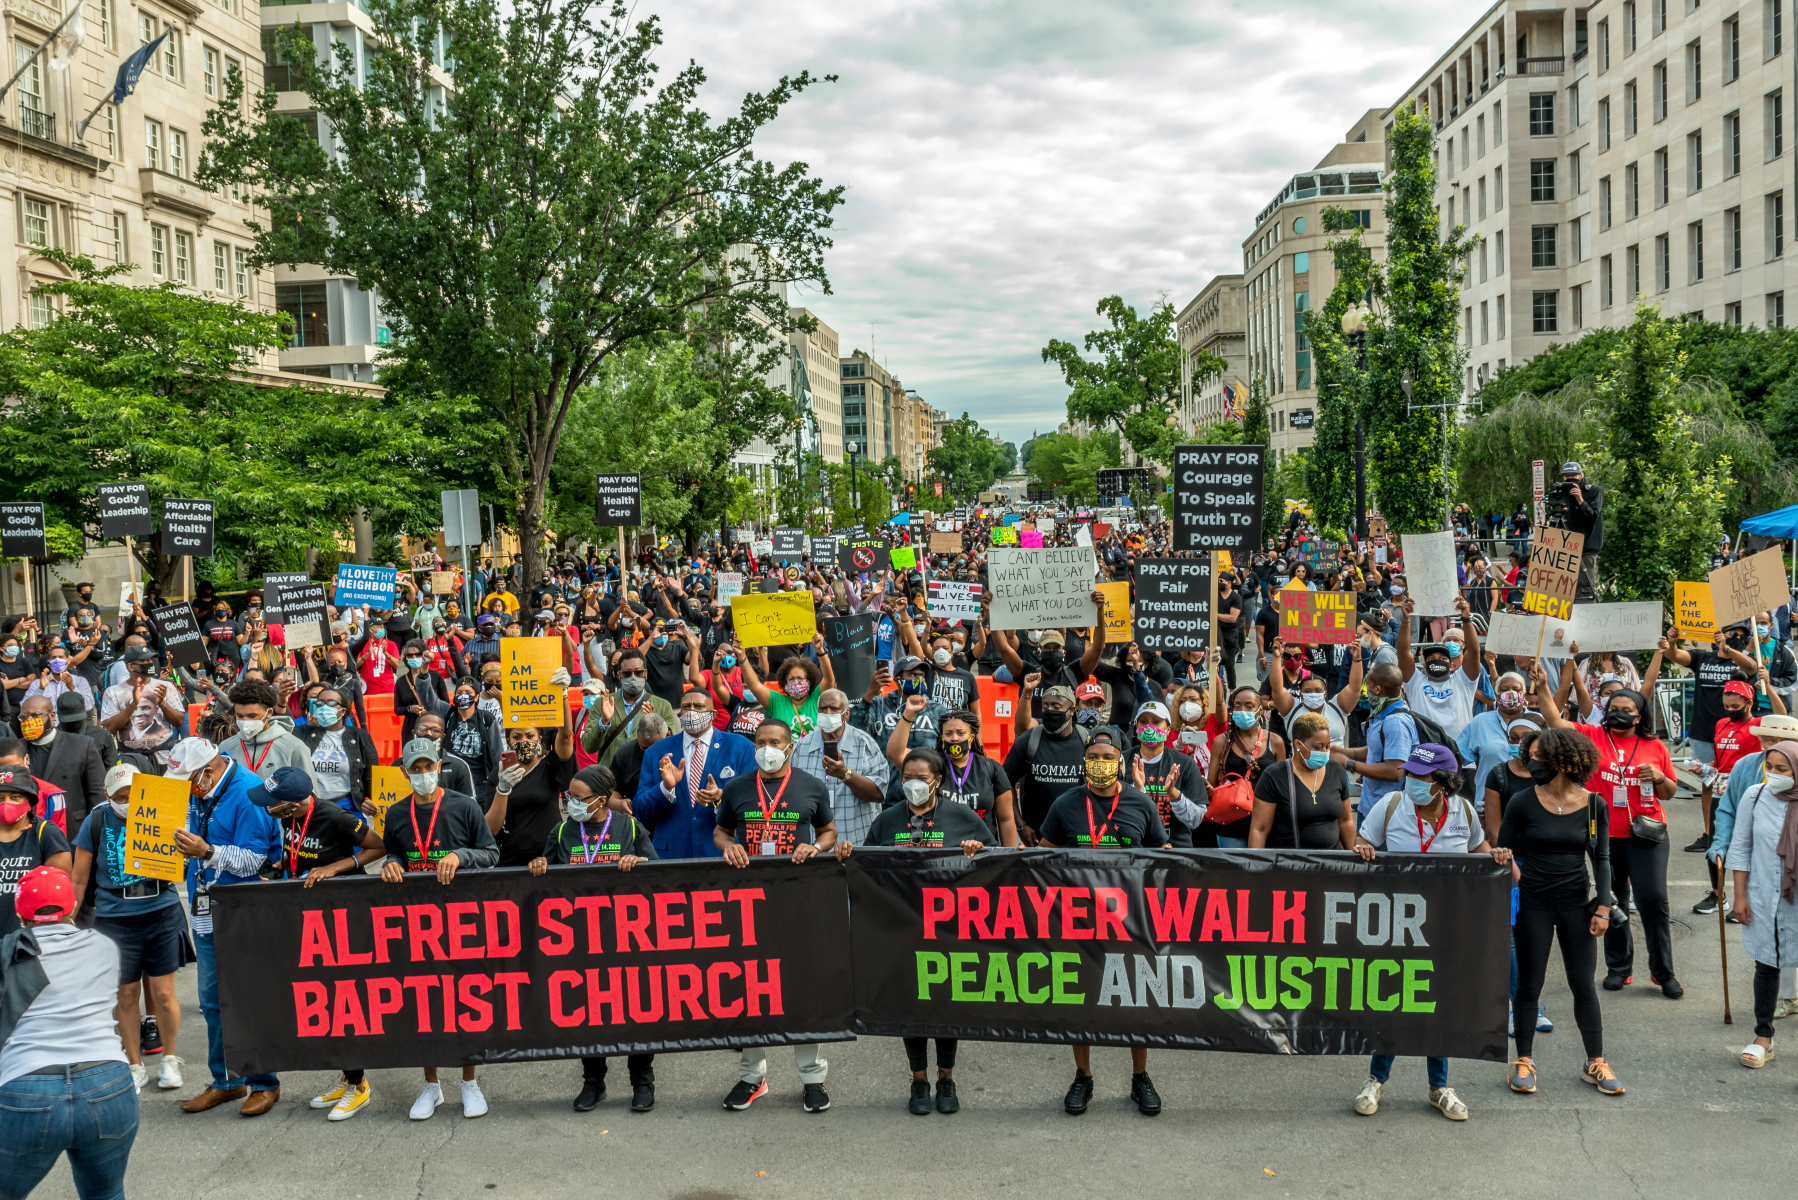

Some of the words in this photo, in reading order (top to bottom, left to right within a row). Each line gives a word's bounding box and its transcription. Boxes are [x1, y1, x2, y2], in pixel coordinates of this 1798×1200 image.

[1178, 452, 1222, 465] PRAY
[1226, 453, 1259, 465] FOR
[598, 476, 620, 484] PRAY
[1182, 470, 1253, 487] Courage
[101, 486, 125, 495] PRAY
[126, 484, 145, 493] FOR
[598, 485, 639, 493] Affordable
[108, 494, 140, 505] Godly
[165, 501, 190, 510] PRAY
[192, 503, 212, 511] FOR
[602, 495, 635, 505] Health
[1178, 491, 1201, 505] To
[1204, 491, 1256, 508] Speak
[1, 506, 24, 514] PRAY
[24, 506, 41, 514] FOR
[102, 505, 149, 518] Leadership
[608, 508, 631, 517] Care
[7, 516, 36, 525] Godly
[164, 512, 212, 522] Affordable
[1181, 512, 1226, 526] Truth
[1230, 512, 1252, 526] To
[2, 528, 44, 538] Leadership
[168, 523, 207, 534] Health
[173, 536, 201, 547] Care
[839, 538, 849, 546] NO
[851, 540, 884, 549] JUSTICE
[1190, 533, 1243, 546] Power
[1045, 549, 1090, 564] BELIEVE
[1299, 551, 1319, 562] Black
[1531, 545, 1580, 574] KNEE
[994, 567, 1031, 581] WHAT
[1039, 567, 1059, 579] YOU
[1063, 566, 1084, 578] SAY
[1140, 564, 1178, 576] PRAY
[1181, 565, 1210, 576] FOR
[1729, 557, 1757, 578] BLACK
[266, 575, 288, 584] PRAY
[289, 574, 307, 582] FOR
[338, 578, 395, 593] NEIGHBOR
[1530, 567, 1556, 591] OFF
[1555, 573, 1578, 597] MY
[1731, 569, 1760, 594] LIVES
[941, 582, 969, 591] BLACK
[995, 582, 1050, 599] BECAUSE
[1055, 580, 1065, 595] I
[1071, 579, 1094, 593] SEE
[1159, 581, 1189, 593] Fair
[281, 590, 304, 601] PRAY
[306, 587, 323, 597] FOR
[353, 593, 387, 602] EXCEPTIONS)
[936, 591, 974, 601] LIVES
[1730, 584, 1766, 612] MATTER
[283, 600, 325, 612] Affordable
[1008, 599, 1040, 613] WHAT
[1042, 598, 1063, 611] YOU
[1139, 599, 1209, 613] Treatment
[1282, 592, 1308, 608] WE
[1314, 593, 1355, 610] WILL
[1523, 590, 1572, 621] NECK
[1681, 600, 1697, 608] AM
[155, 609, 175, 621] PRAY
[175, 606, 190, 616] FOR
[931, 603, 974, 613] MATTER
[1680, 609, 1702, 618] THE
[289, 611, 323, 625] Health
[739, 611, 752, 627] I
[1324, 612, 1346, 628] BE
[1616, 607, 1649, 627] THEIR
[164, 618, 189, 632] Godly
[1137, 616, 1156, 629] Of
[1159, 617, 1210, 632] People
[1498, 614, 1547, 635] Blac
[766, 624, 814, 639] Breathe
[834, 621, 864, 642] Black
[1278, 626, 1357, 645] SILENCED
[164, 630, 200, 647] Leadership
[1143, 634, 1162, 647] Of
[1164, 635, 1204, 648] Color
[512, 650, 516, 661] I
[509, 665, 532, 676] AM
[1699, 672, 1731, 680] matte
[509, 679, 538, 691] THE
[1085, 683, 1102, 694] DC
[509, 694, 557, 706] NAACP.
[1728, 730, 1735, 738] I
[1618, 749, 1625, 763] I
[312, 761, 340, 773] MORE
[380, 778, 384, 787] I
[1034, 775, 1080, 783] #blacklivesmatter
[141, 788, 145, 801] I
[378, 792, 397, 801] AM
[135, 805, 157, 820] AM
[134, 821, 161, 838] THE
[745, 823, 766, 831] PRAYER
[105, 827, 118, 866] MICAH
[132, 839, 178, 857] NAACP.
[746, 843, 794, 856] JUICE
[0, 856, 33, 867] QUIT
[108, 867, 120, 883] 6:8
[0, 883, 18, 896] QUI
[921, 885, 1133, 942] PRAYER
[1144, 887, 1307, 944] WALK
[1322, 891, 1429, 947] FOR
[297, 897, 522, 968] ALFRED
[537, 886, 767, 957] STREET
[914, 950, 1085, 1005] PEACE
[1096, 952, 1206, 1009] AND
[1213, 954, 1437, 1013] JUSTICE
[291, 969, 531, 1037] BAPTIST
[547, 957, 786, 1028] CHURCH
